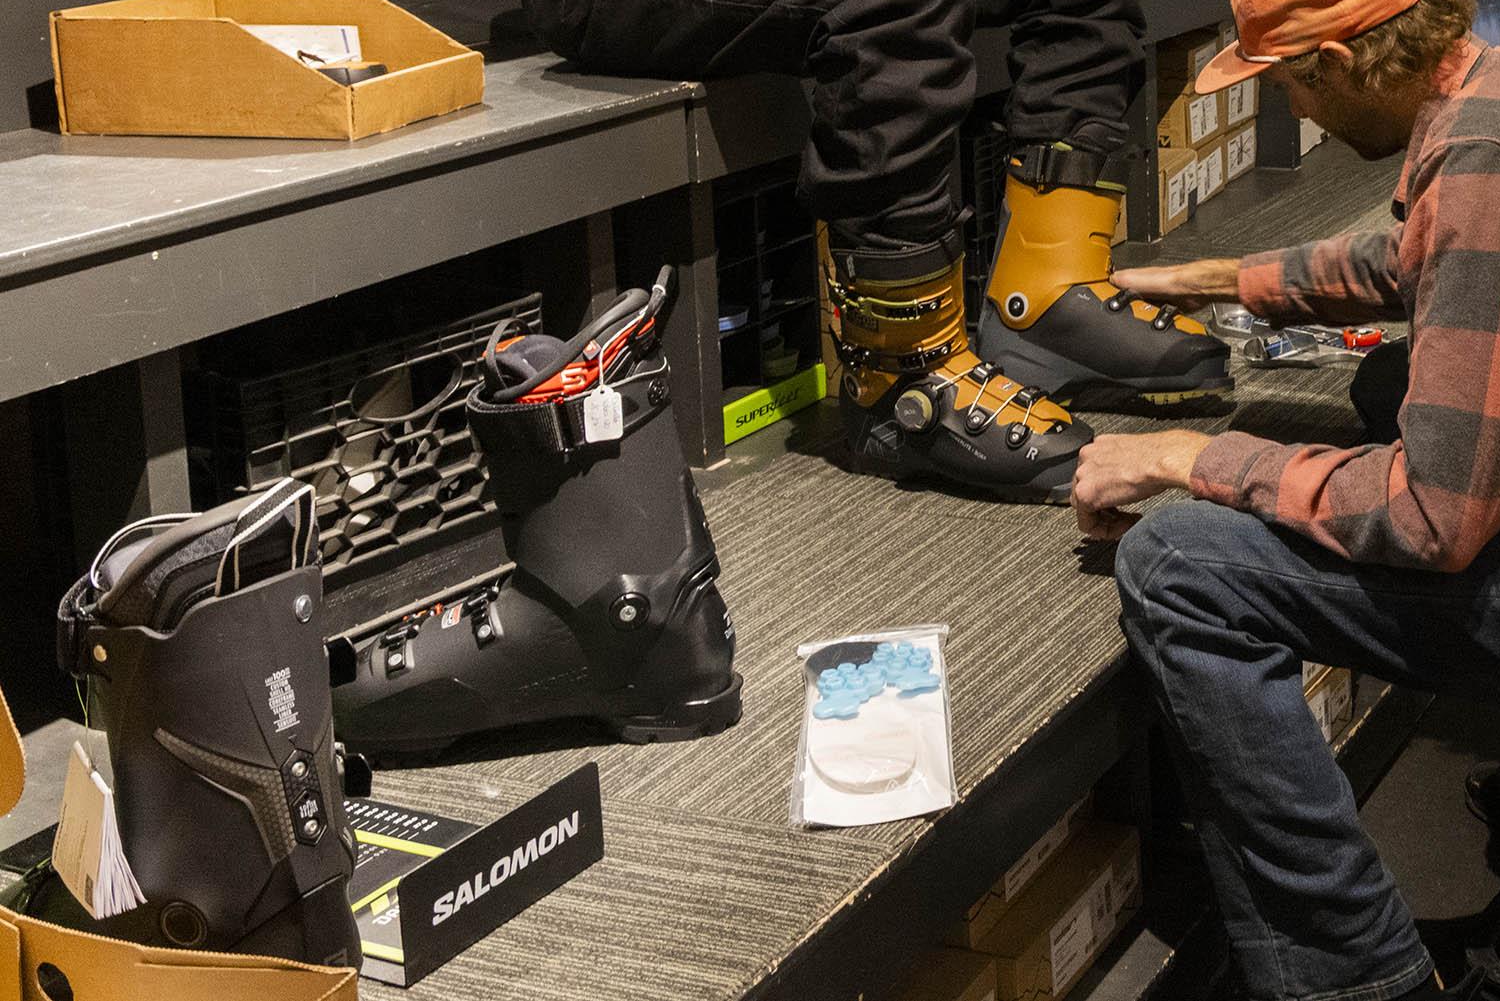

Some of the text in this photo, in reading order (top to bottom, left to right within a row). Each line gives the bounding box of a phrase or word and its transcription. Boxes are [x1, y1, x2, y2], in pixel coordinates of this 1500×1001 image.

[273, 669, 286, 682] 100
[270, 679, 289, 691] CUSTOM
[432, 811, 580, 926] SALOMON
